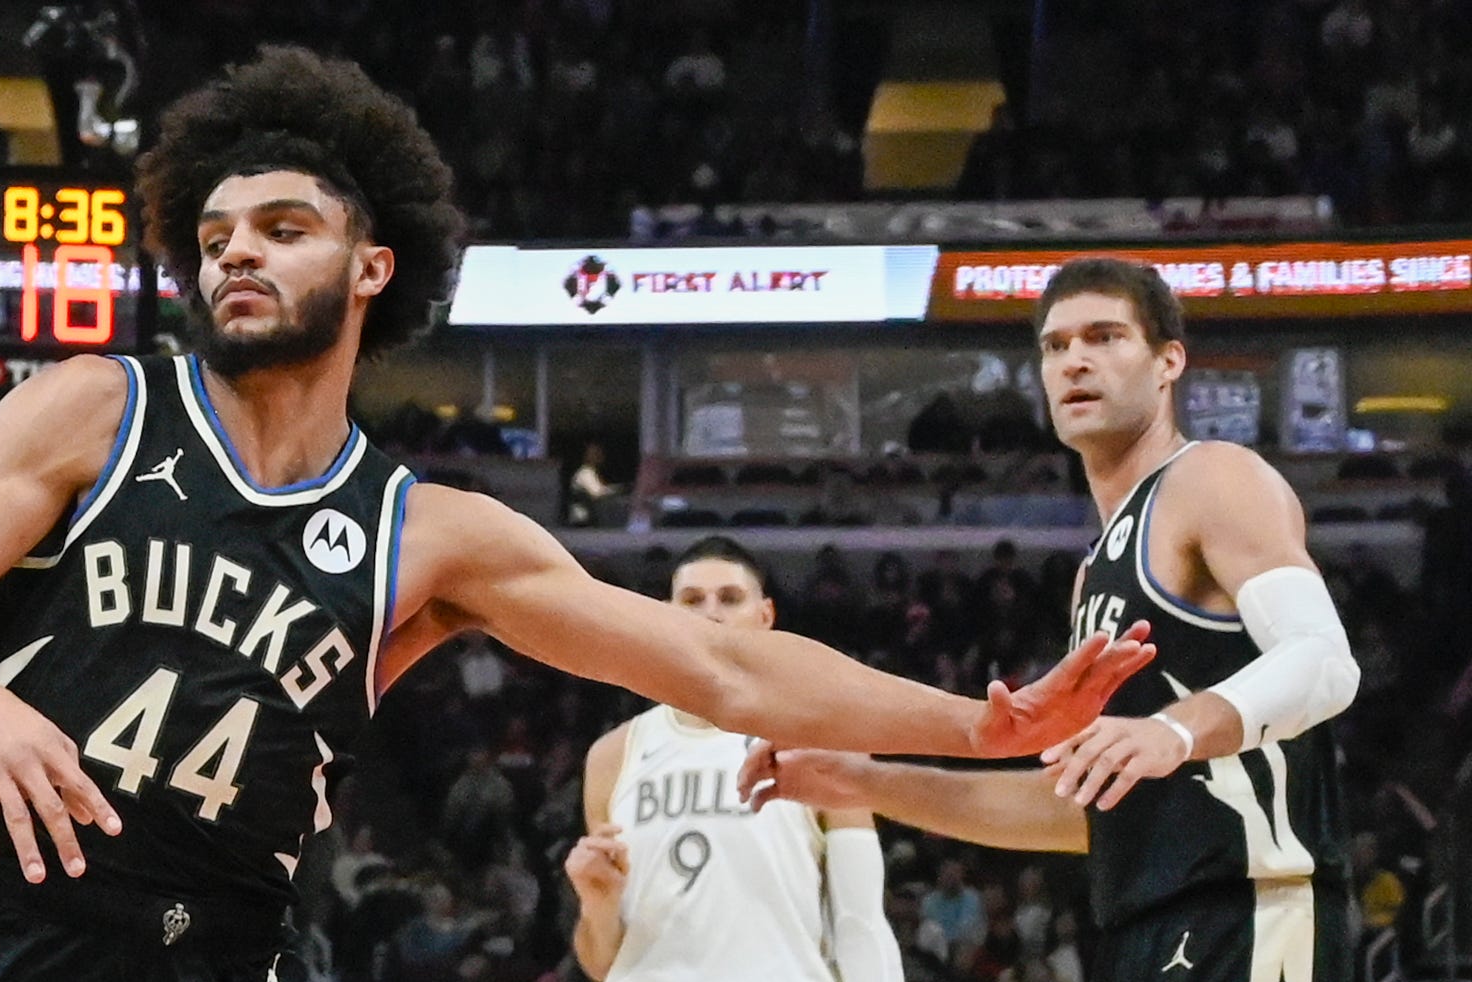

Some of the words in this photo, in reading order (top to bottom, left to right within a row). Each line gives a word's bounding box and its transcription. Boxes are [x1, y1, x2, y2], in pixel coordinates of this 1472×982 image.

[4, 187, 125, 245] 8:36
[21, 243, 113, 344] 18
[632, 271, 717, 293] FIRST
[729, 270, 828, 292] ALERT
[1256, 258, 1386, 296] FAMILIES
[1389, 254, 1471, 292] SINCE
[83, 536, 357, 712] BUCKS
[81, 664, 263, 823] 44
[668, 830, 712, 894] 9
